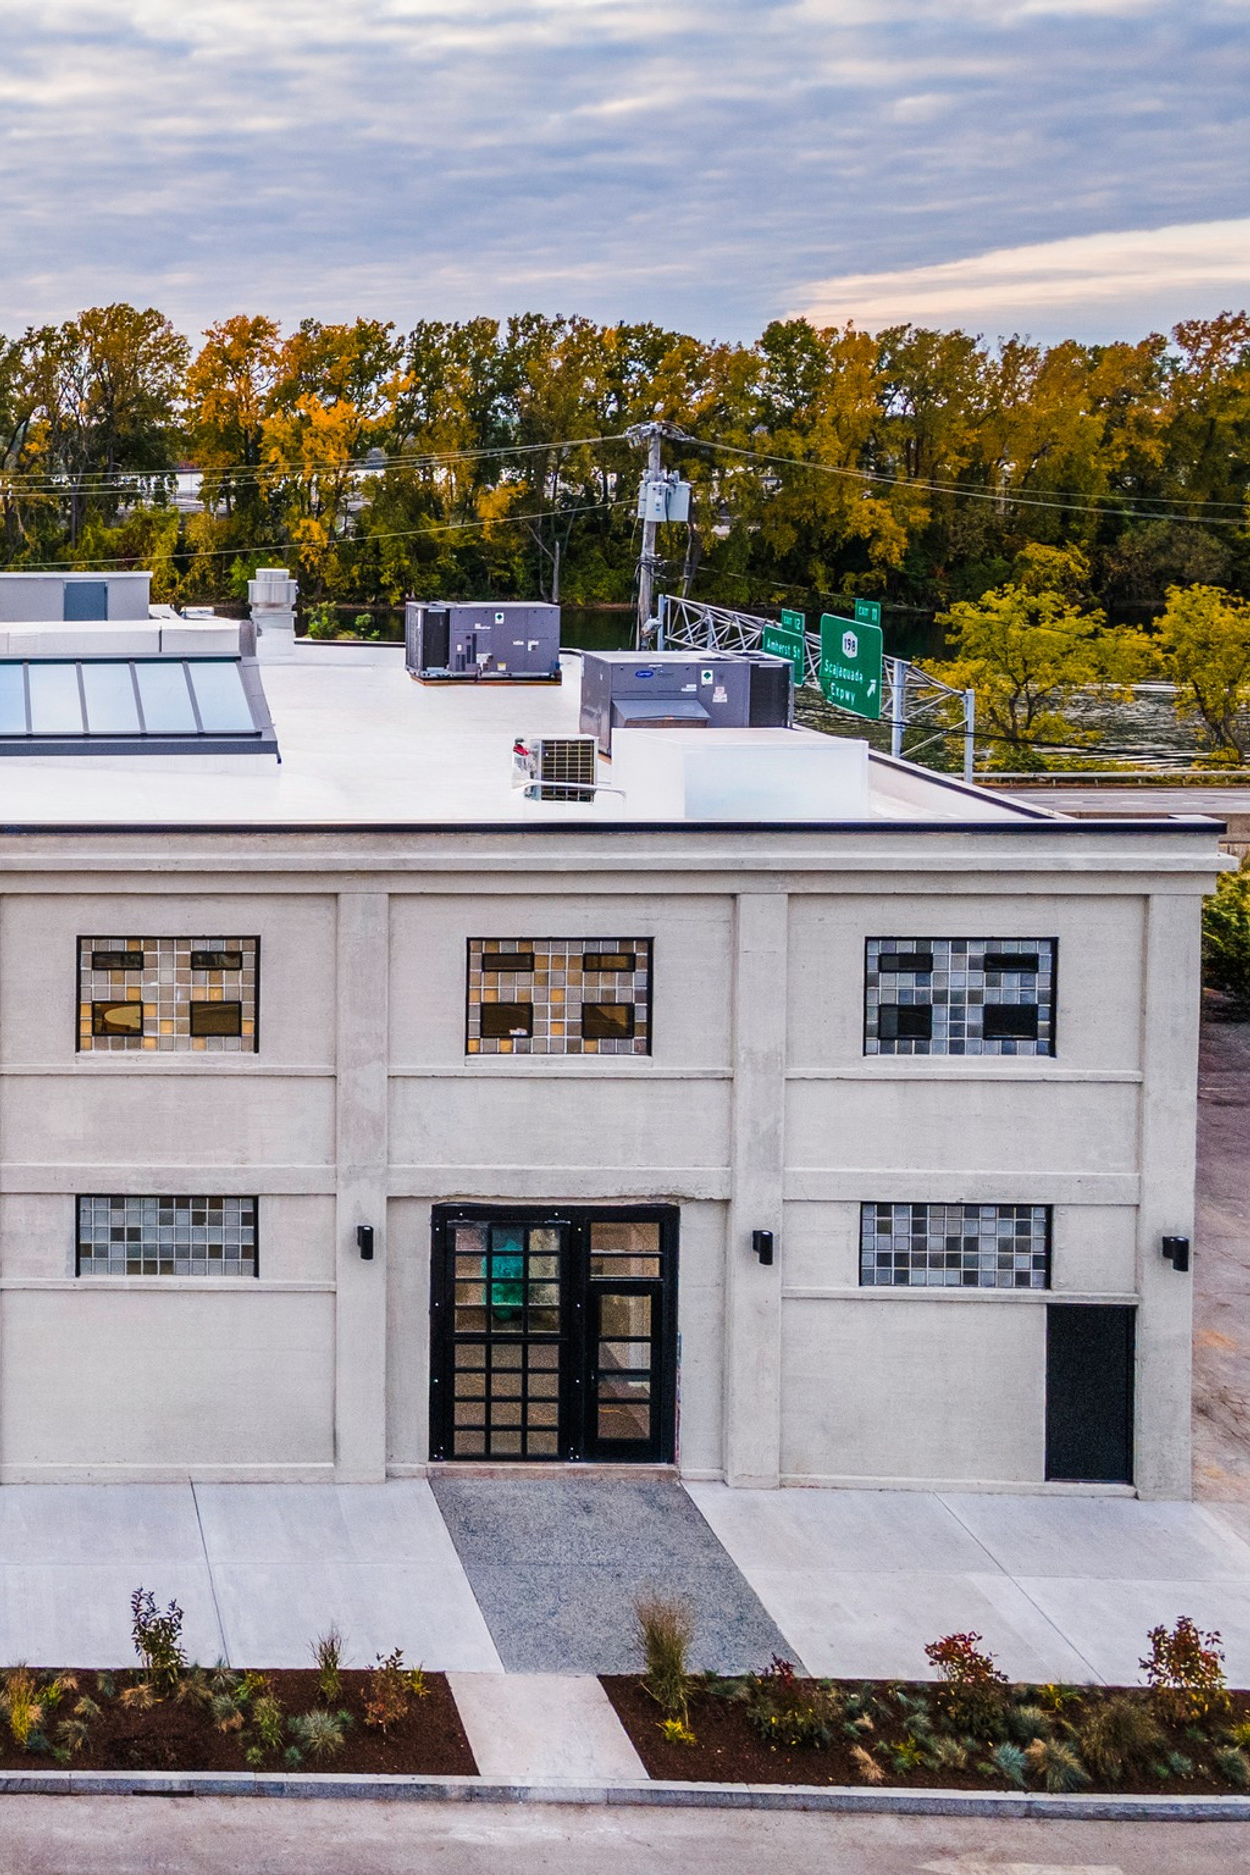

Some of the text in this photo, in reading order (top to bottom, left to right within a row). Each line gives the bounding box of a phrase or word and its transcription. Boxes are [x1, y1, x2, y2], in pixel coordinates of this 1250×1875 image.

[794, 617, 801, 630] 12
[766, 636, 801, 659] Amherst St
[844, 638, 856, 652] 198
[824, 658, 863, 684] Scajaquada
[830, 682, 856, 705] Expwy
